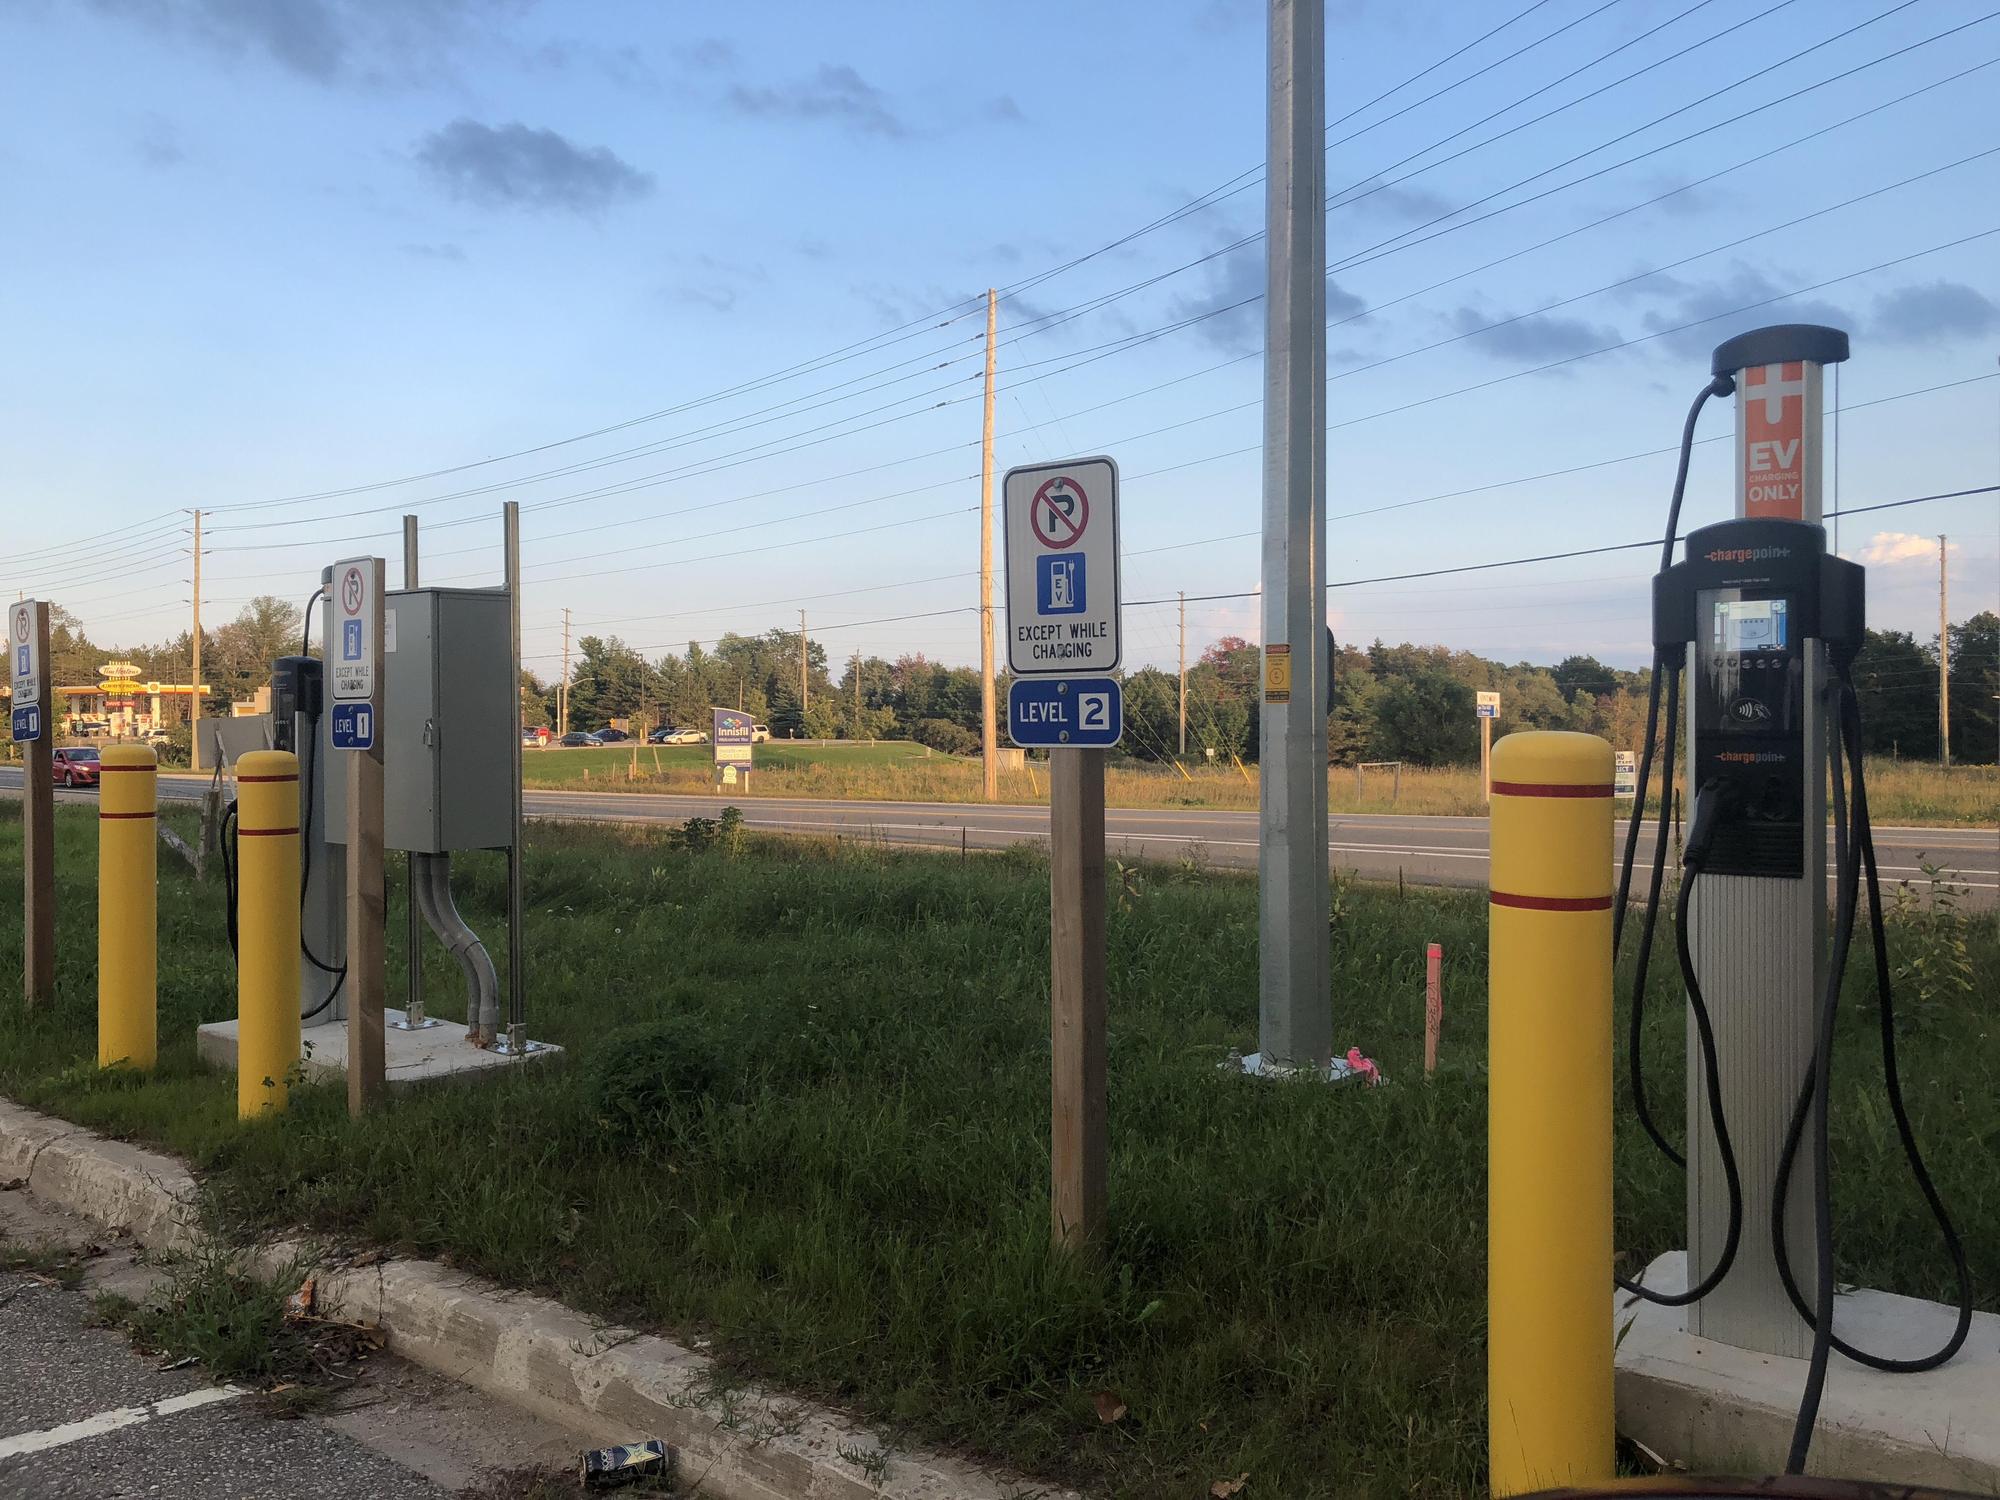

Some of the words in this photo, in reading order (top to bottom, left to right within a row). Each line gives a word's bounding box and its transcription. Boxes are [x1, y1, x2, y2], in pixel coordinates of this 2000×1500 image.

[1750, 438, 1800, 471] EV
[1749, 472, 1799, 482] CHARGING
[1749, 484, 1800, 502] ONLY
[1018, 625, 1062, 641] EXCEPT
[1070, 622, 1107, 639] WHILE
[336, 666, 353, 678] EXCEPT
[355, 665, 369, 677] WHILE
[341, 679, 364, 691] CHAGING
[1019, 702, 1068, 722] LEVEL
[1084, 697, 1104, 725] 2
[14, 718, 28, 731] LEVEL
[335, 719, 354, 733] LEVEL
[718, 727, 749, 736] Innisfil
